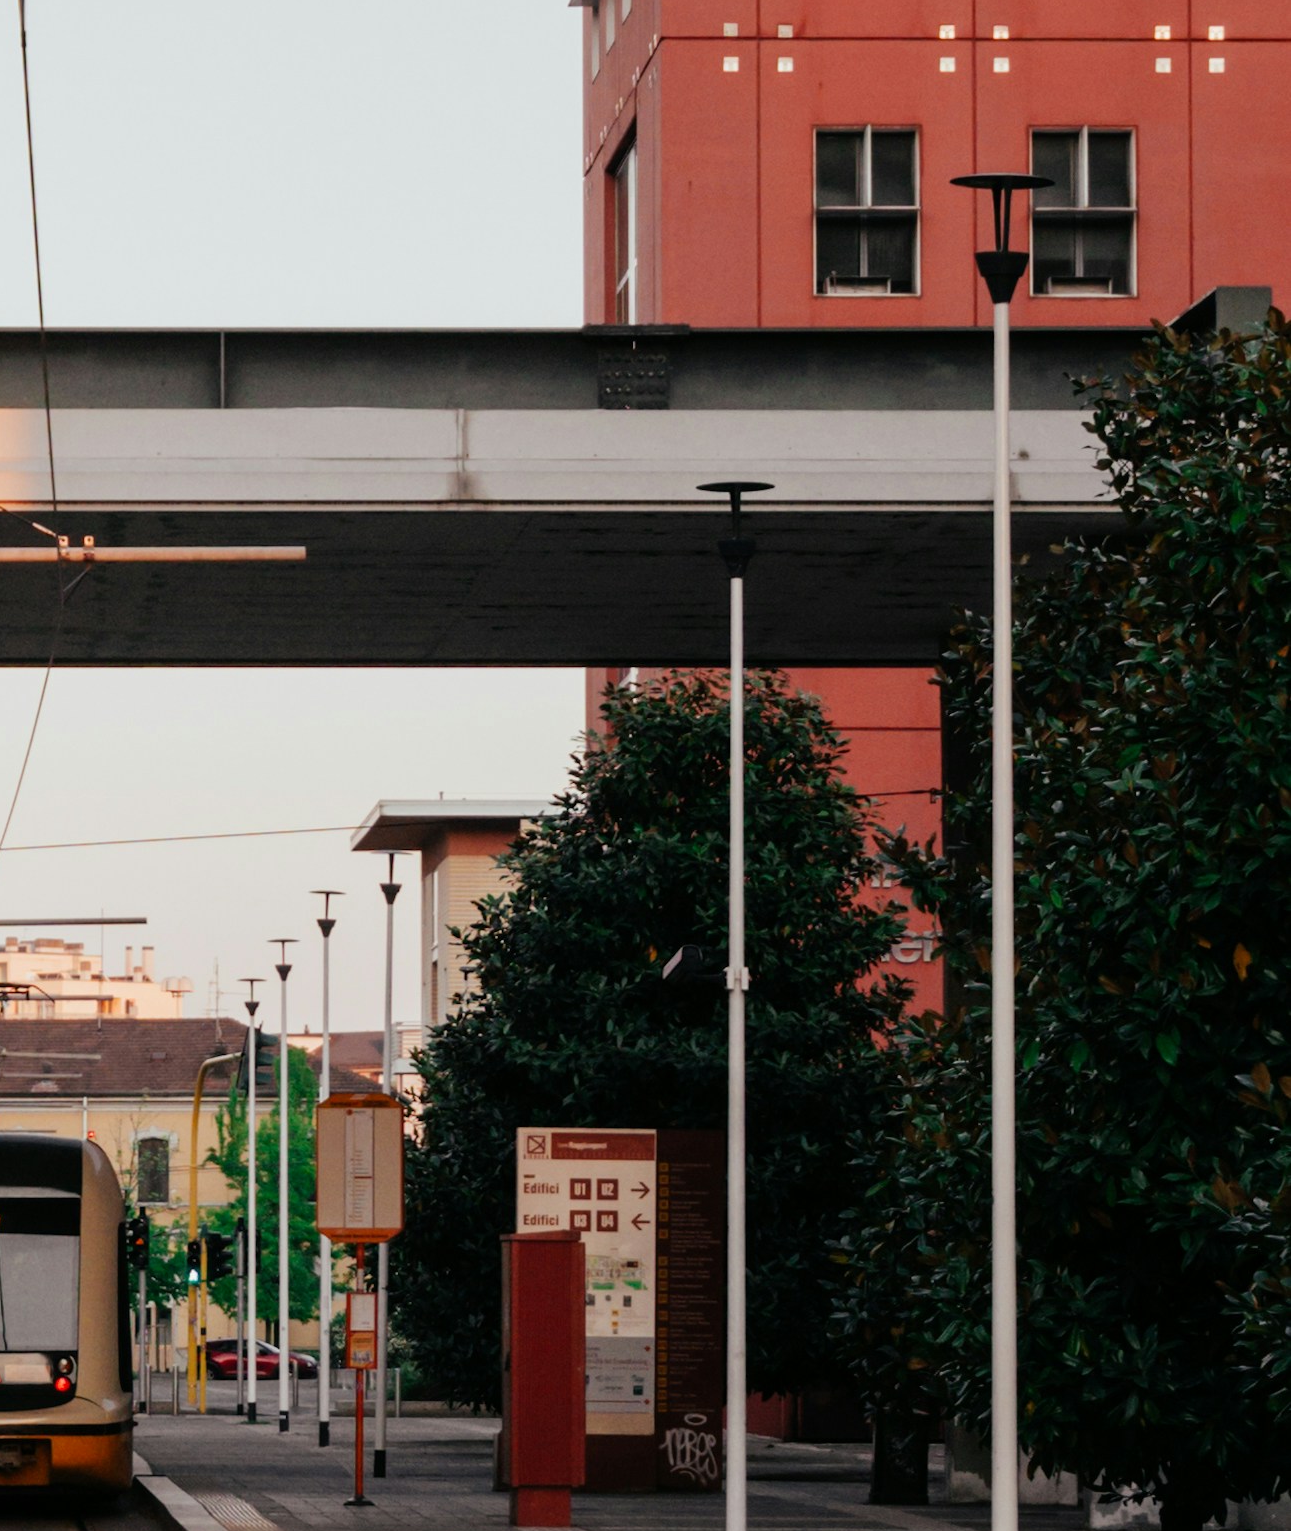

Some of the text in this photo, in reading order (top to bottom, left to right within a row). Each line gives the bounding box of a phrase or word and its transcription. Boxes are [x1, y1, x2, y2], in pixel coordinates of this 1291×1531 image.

[523, 1182, 614, 1196] Edifici U1 U2
[523, 1214, 614, 1228] Edifici U3 U4
